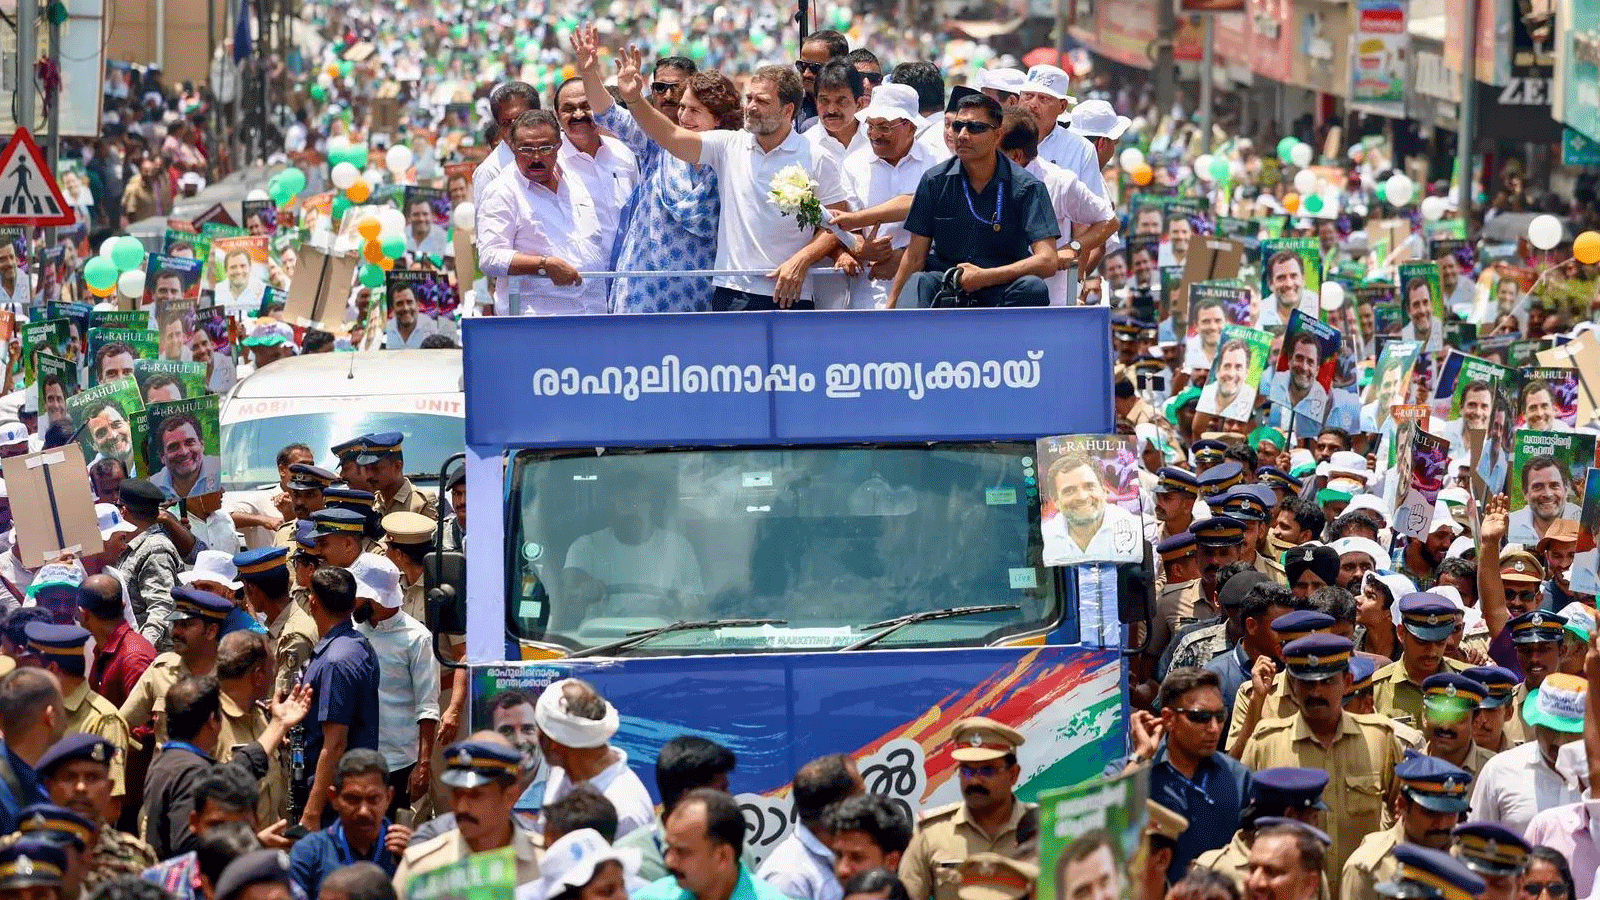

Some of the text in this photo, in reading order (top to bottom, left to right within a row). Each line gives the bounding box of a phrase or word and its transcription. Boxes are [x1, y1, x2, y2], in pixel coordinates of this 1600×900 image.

[107, 313, 138, 321] RAHUL
[109, 331, 144, 341] RAHUL
[154, 363, 190, 373] RAHUL
[532, 350, 1044, 402] രാഹുലിനൊപ്പം ഇന്ത്യക്കായ്
[1534, 370, 1563, 379] RAHUL
[84, 383, 120, 402] RAHUL
[167, 402, 203, 415] RAHUL
[415, 400, 461, 413] UNIT
[1066, 440, 1114, 452] RAHUL
[1116, 440, 1127, 451] JI
